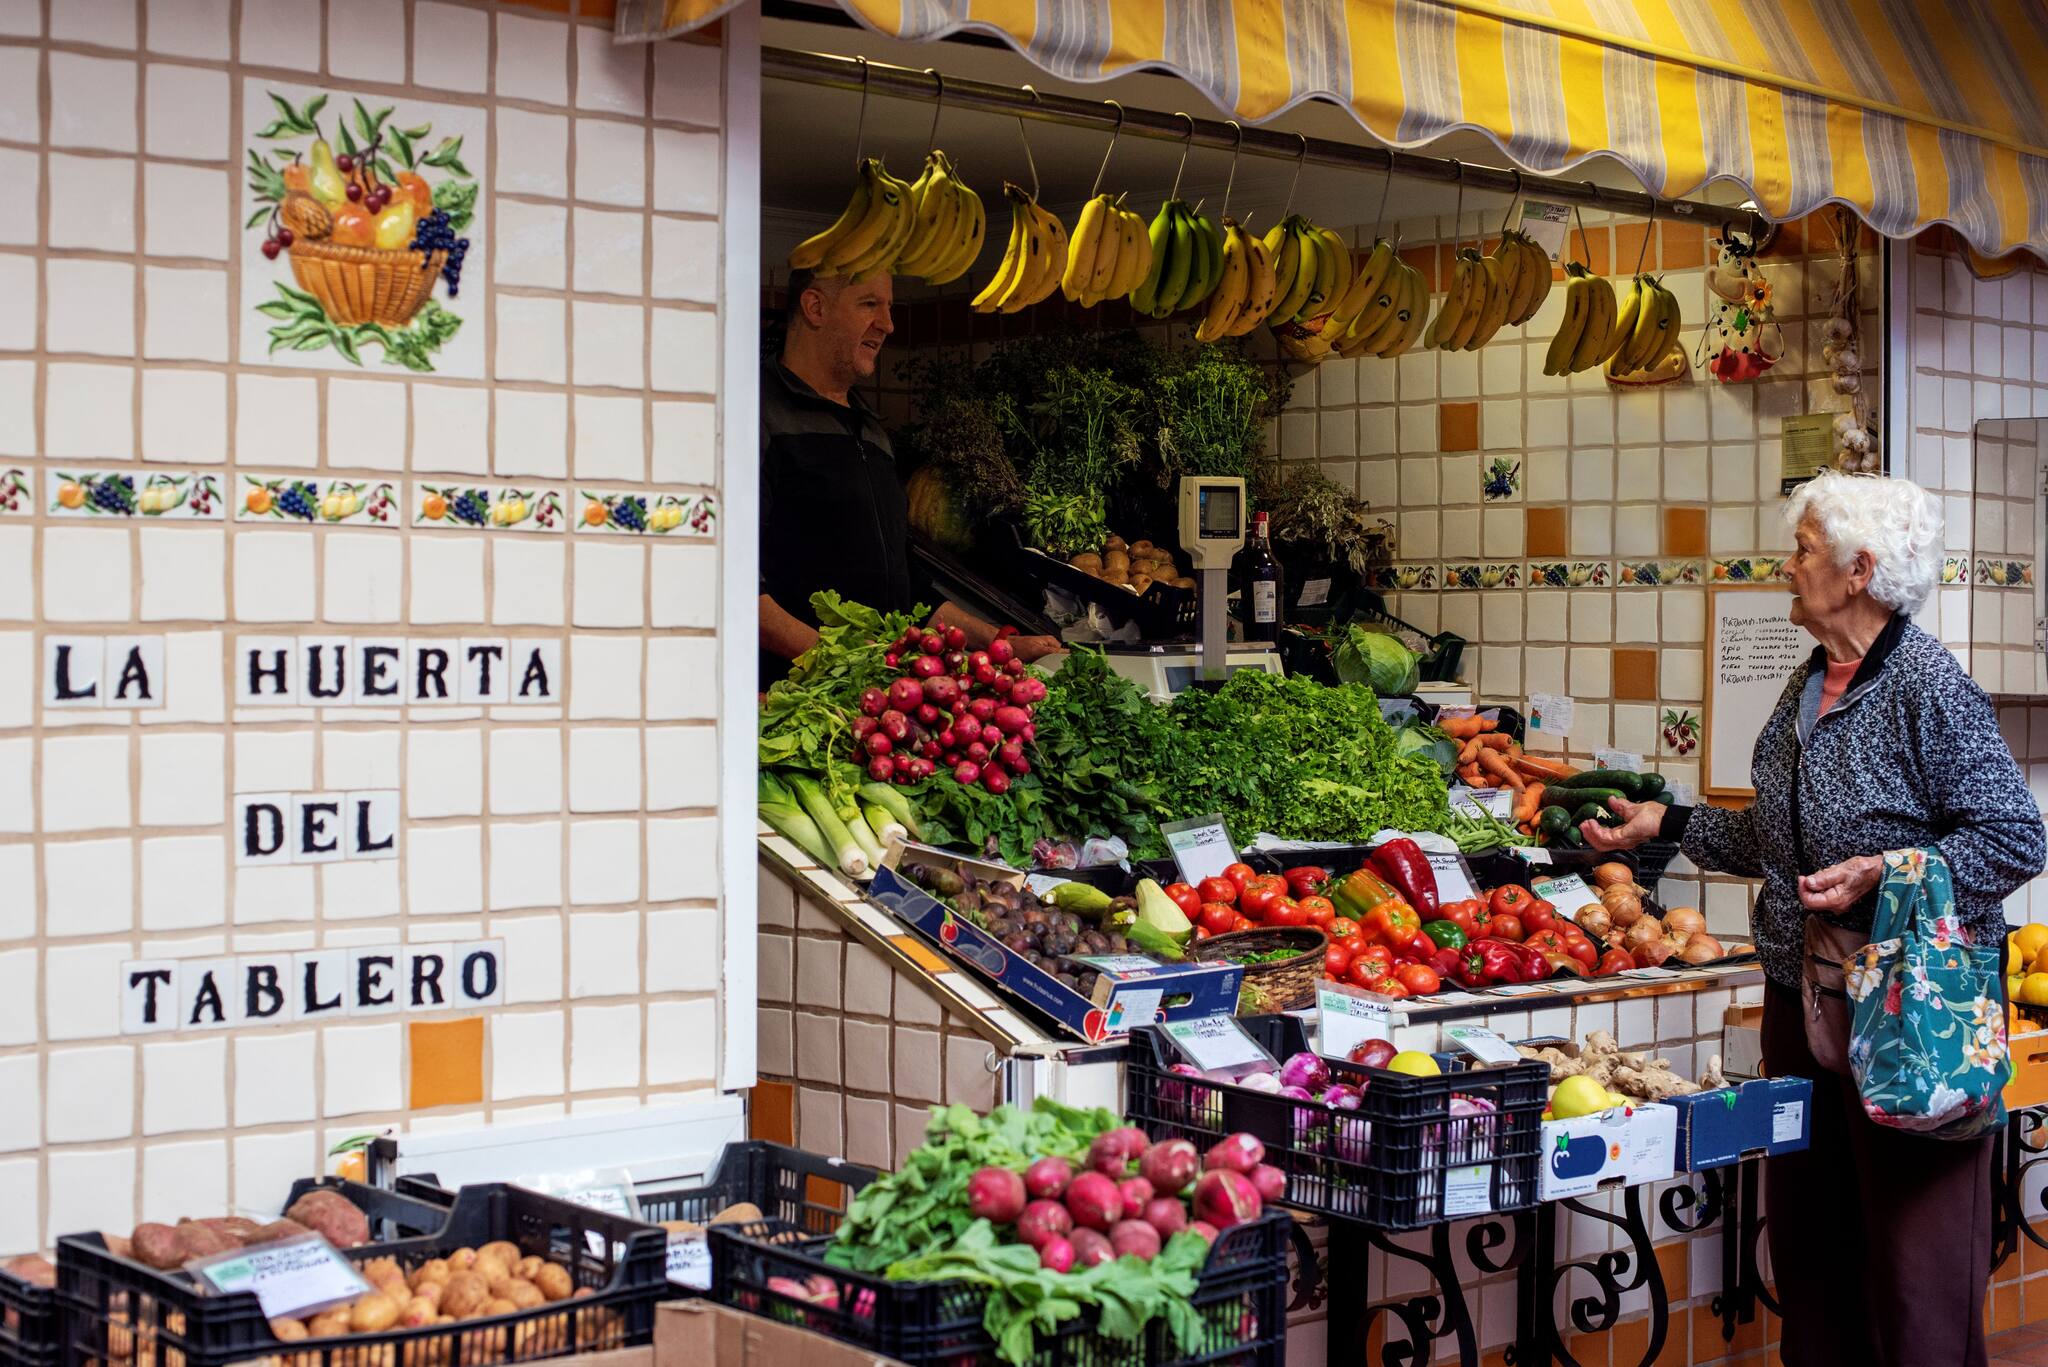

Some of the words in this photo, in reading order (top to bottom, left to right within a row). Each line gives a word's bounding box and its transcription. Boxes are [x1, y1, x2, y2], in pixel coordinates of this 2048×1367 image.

[55, 645, 152, 700] LA
[249, 645, 550, 699] HUERTA
[245, 800, 393, 856] DEL
[130, 951, 497, 1024] TABLERO
